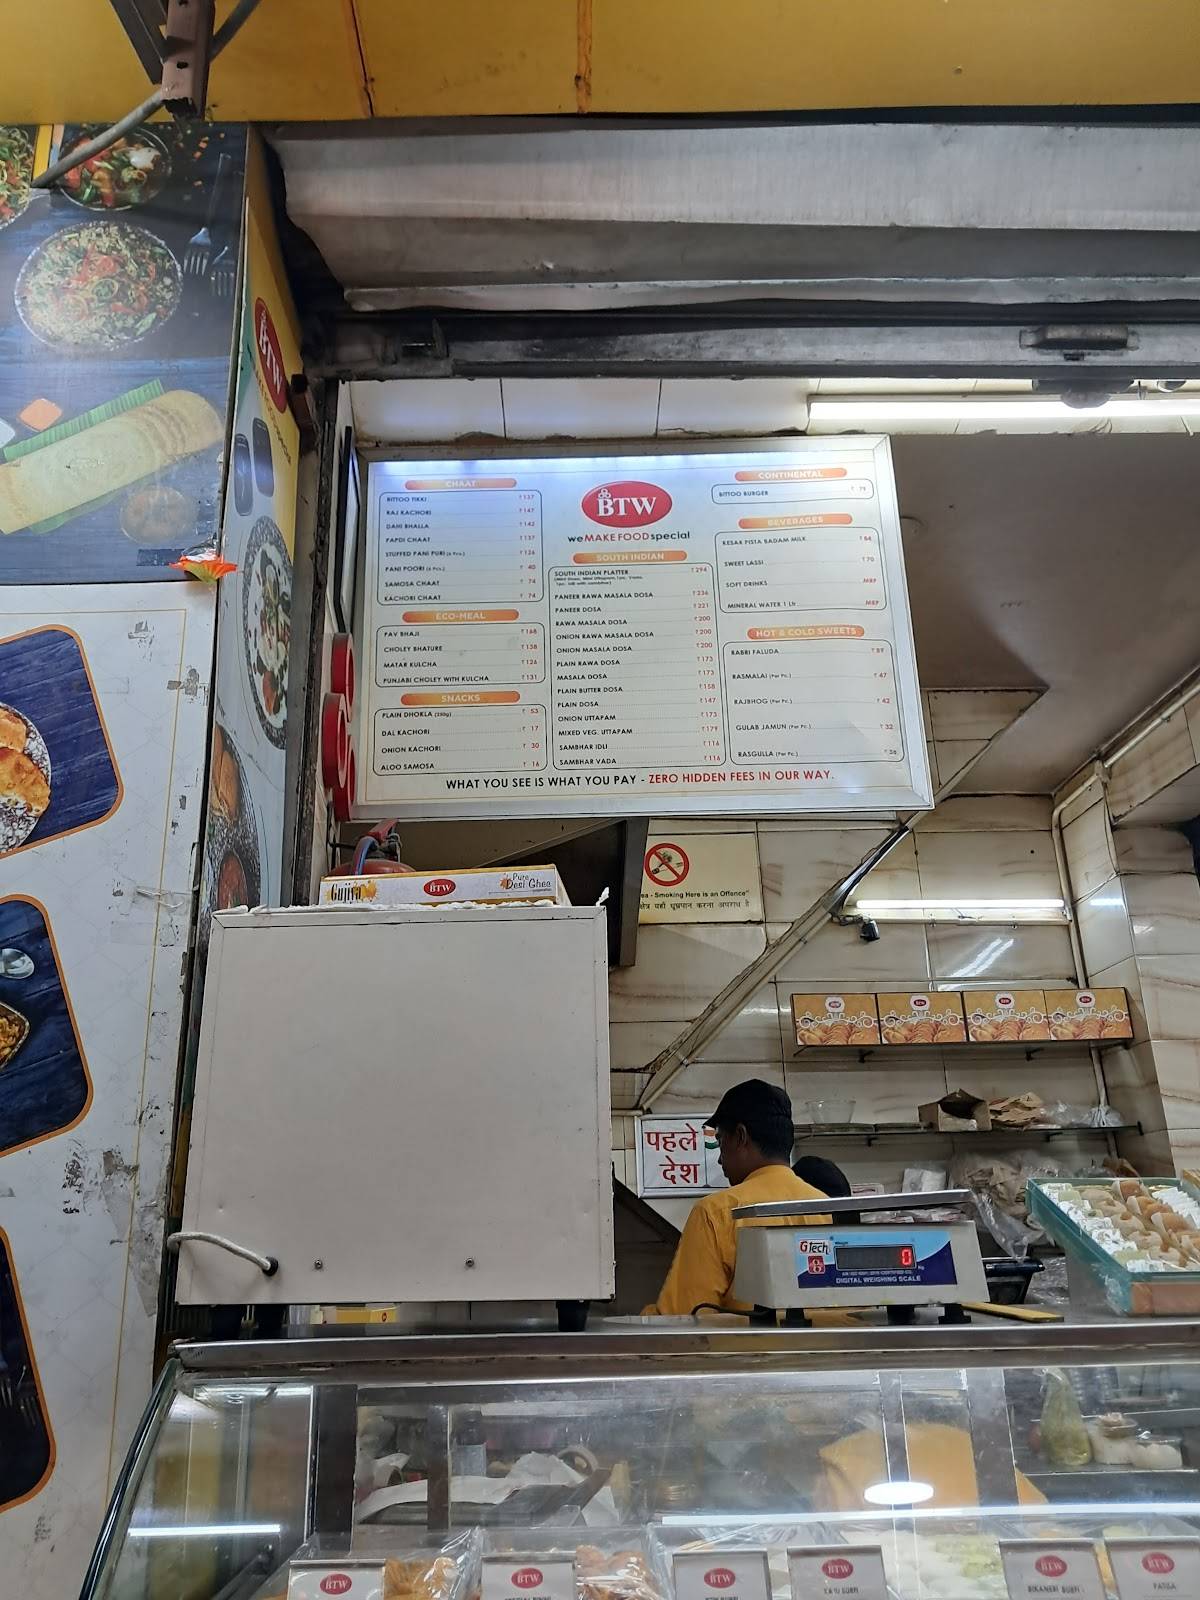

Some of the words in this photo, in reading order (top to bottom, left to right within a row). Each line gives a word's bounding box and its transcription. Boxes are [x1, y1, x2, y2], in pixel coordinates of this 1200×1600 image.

[758, 470, 825, 480] CONTINENTAL
[446, 480, 477, 488] CHAAT
[597, 496, 657, 517] BTW
[767, 516, 824, 526] BEVERAGES
[584, 534, 617, 542] MAKE
[618, 533, 649, 541] FOOD
[650, 531, 690, 541] special
[436, 612, 486, 620] ECO-MEAL
[817, 627, 857, 635] SWEETS
[441, 694, 480, 702] SNACKS
[446, 779, 479, 789] WHAT
[483, 778, 508, 788] YOU
[512, 777, 531, 787] SEE
[534, 777, 544, 787] IS
[547, 776, 581, 786] WHAT
[585, 775, 610, 785] YOU
[613, 775, 636, 785] PAY
[648, 774, 679, 784] ZERO
[682, 773, 726, 783] HIDDEN
[730, 772, 755, 782] FEES
[758, 771, 771, 781] IN
[774, 770, 800, 780] OUR
[512, 873, 529, 881] Pure
[429, 882, 451, 893] BTW
[506, 878, 526, 889] Desi
[528, 878, 551, 889] Ghee
[644, 1123, 699, 1152] पहले
[659, 1155, 700, 1184] देश
[901, 1249, 912, 1265] 0
[325, 1578, 348, 1590] BTW
[517, 1573, 540, 1584] BTW
[709, 1574, 730, 1584] BTW
